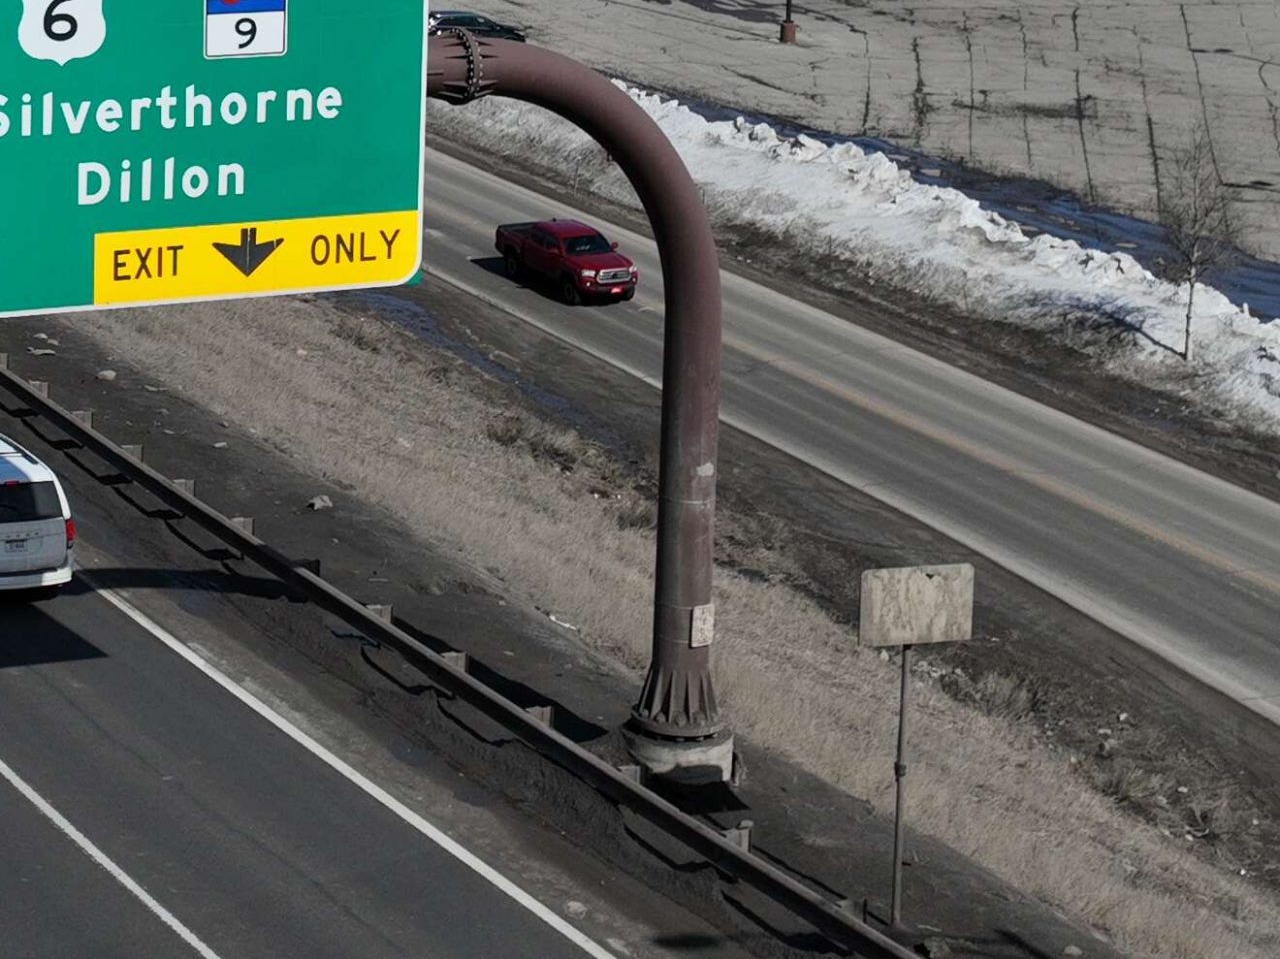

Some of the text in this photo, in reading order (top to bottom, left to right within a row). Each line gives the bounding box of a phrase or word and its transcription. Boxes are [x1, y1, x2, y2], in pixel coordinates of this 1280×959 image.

[234, 17, 257, 49] 9
[78, 157, 244, 206] Dillon
[113, 229, 400, 281] EXIT ONLY
